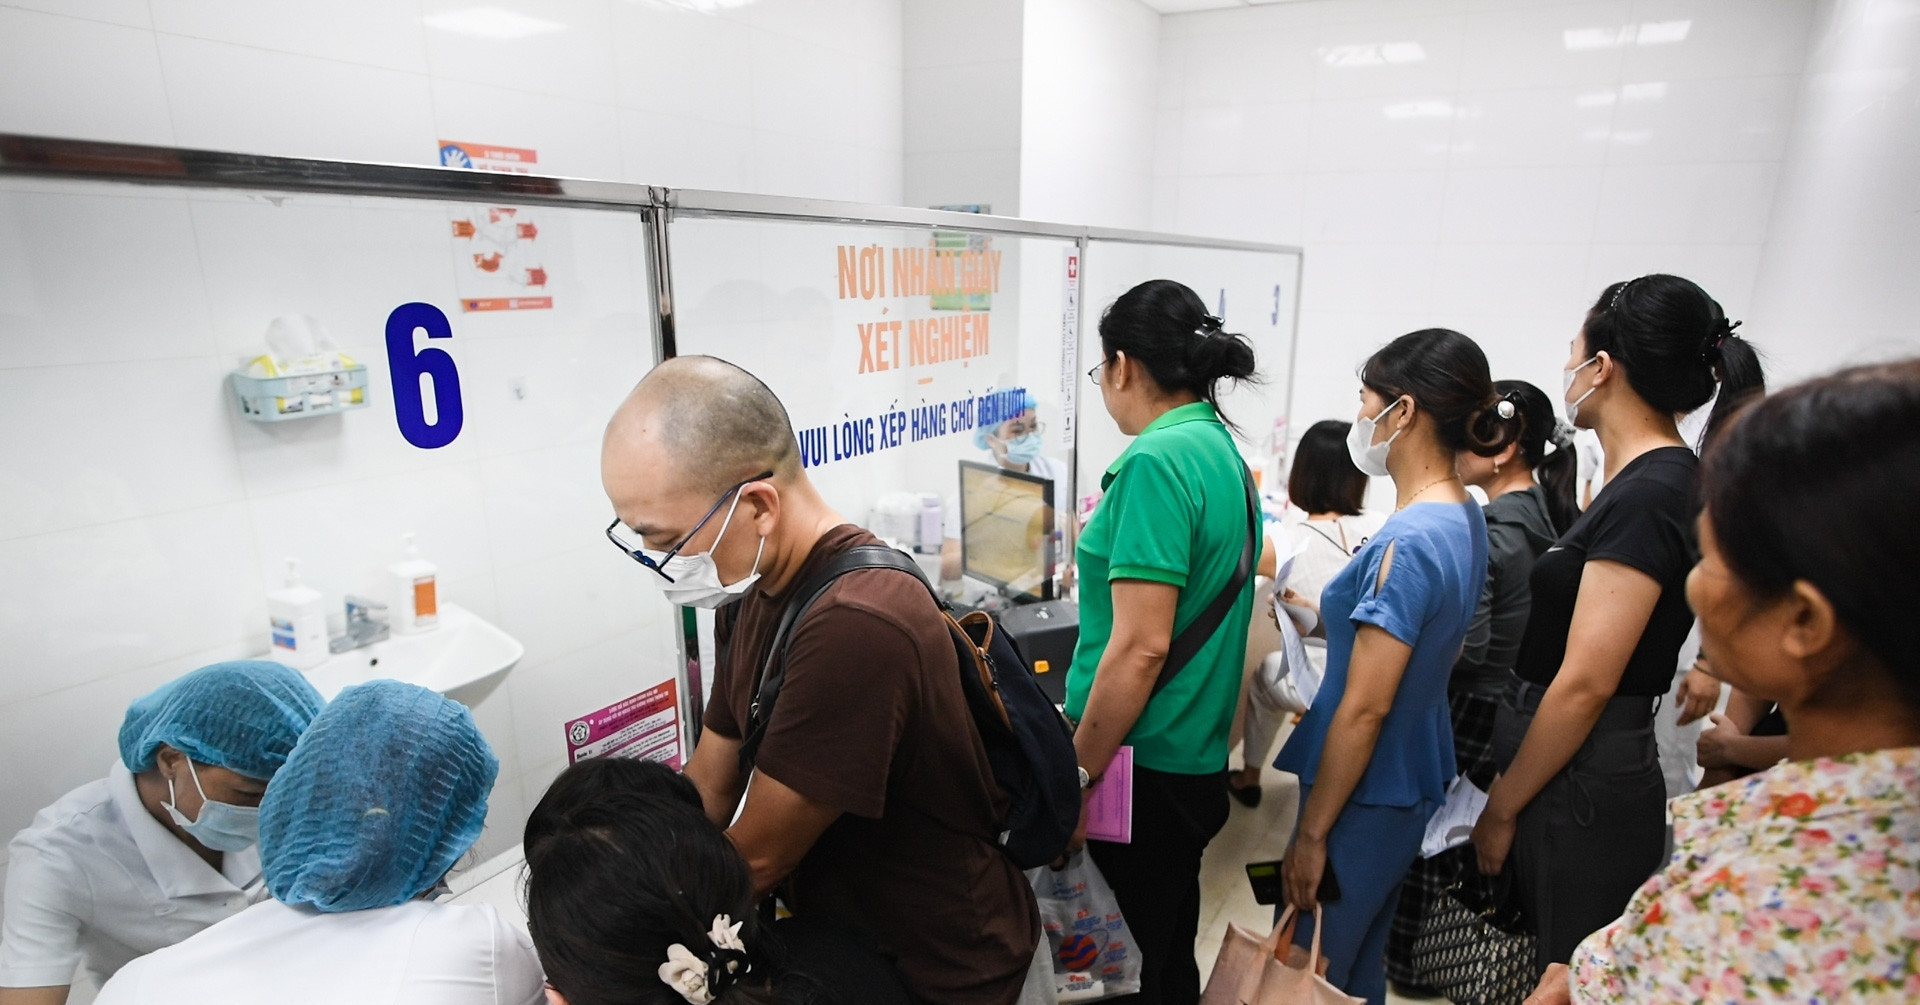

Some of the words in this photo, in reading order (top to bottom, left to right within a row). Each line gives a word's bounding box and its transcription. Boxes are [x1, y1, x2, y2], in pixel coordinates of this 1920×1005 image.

[837, 244, 885, 300] NƠI
[385, 302, 464, 450] 6
[857, 307, 902, 374] XÉT
[908, 304, 990, 368] NGHIỆM
[799, 427, 828, 469] VUI
[833, 412, 875, 461] LÒNG
[879, 398, 907, 450] XẾP
[910, 398, 947, 443] HÀNG
[951, 389, 974, 433] CHỜ
[978, 386, 999, 428] ĐẾN
